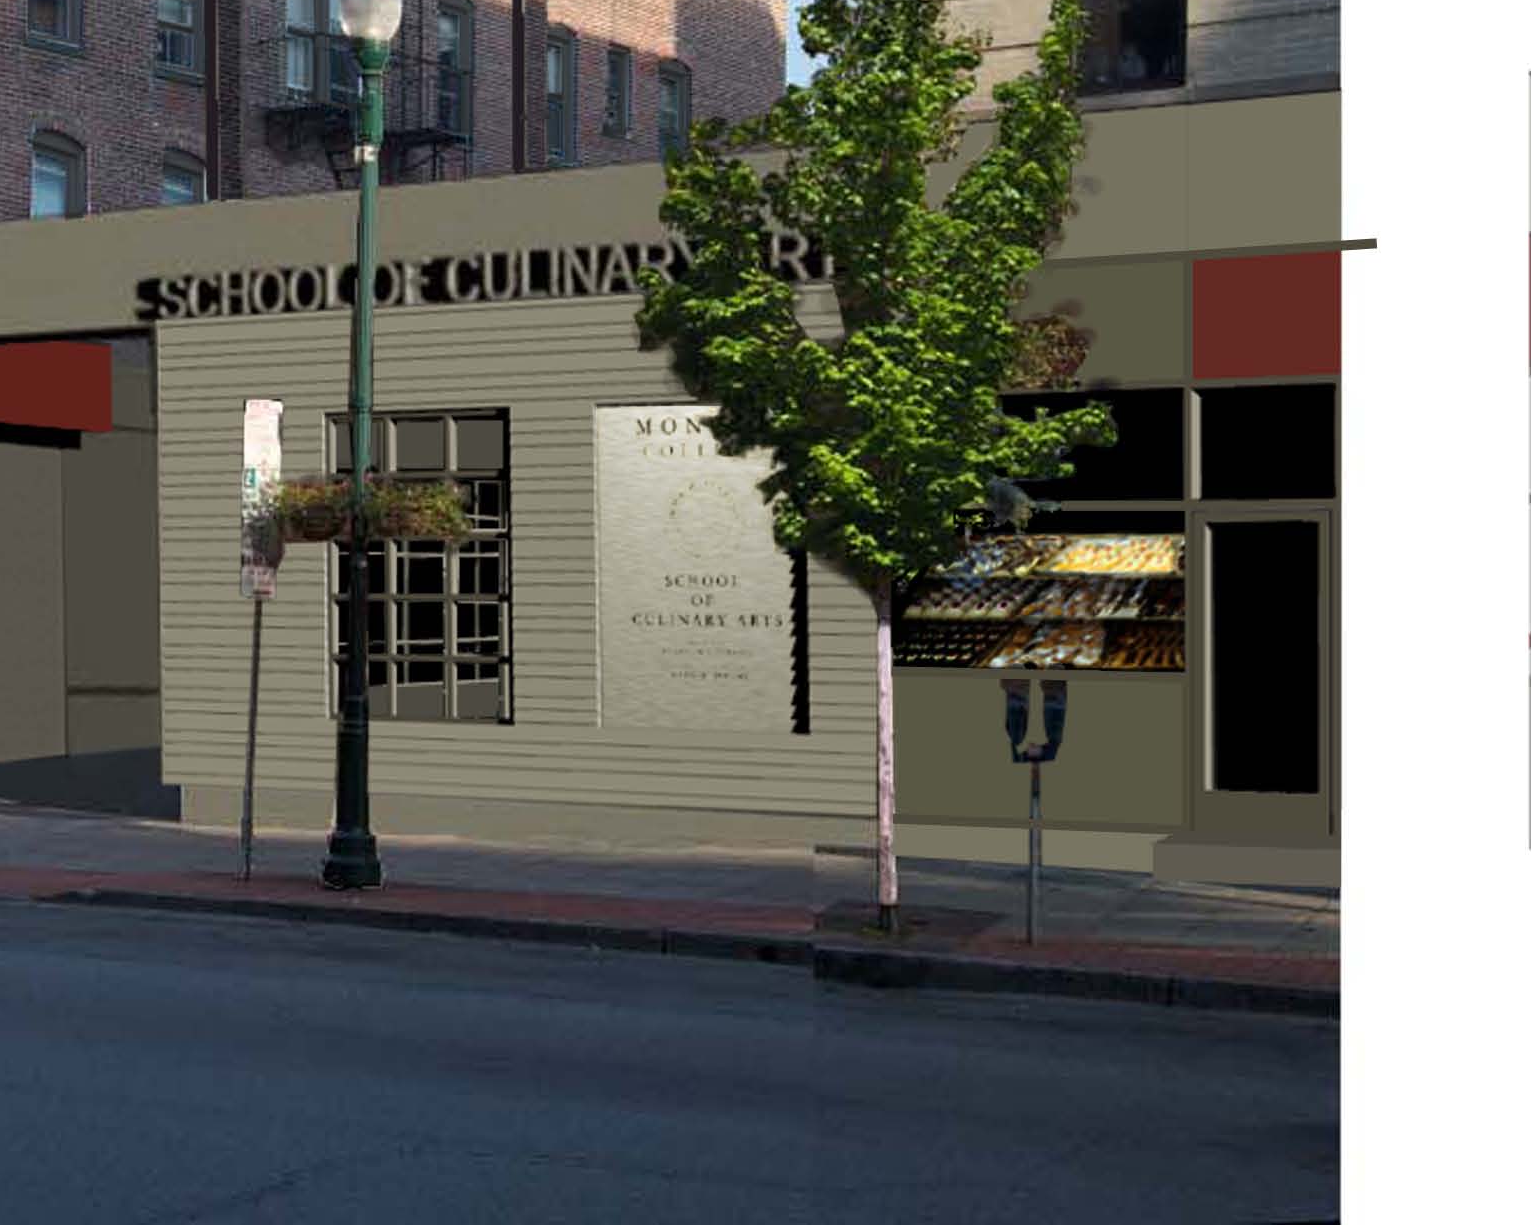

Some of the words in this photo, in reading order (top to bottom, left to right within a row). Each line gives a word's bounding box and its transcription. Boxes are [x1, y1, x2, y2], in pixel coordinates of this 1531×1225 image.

[156, 264, 357, 318] SCHOOL
[368, 258, 431, 306] OF
[636, 416, 702, 436] MON
[664, 575, 738, 587] SCHOOL
[690, 594, 716, 607] OF
[632, 614, 726, 627] CULINARY
[737, 614, 784, 627] ARTS
